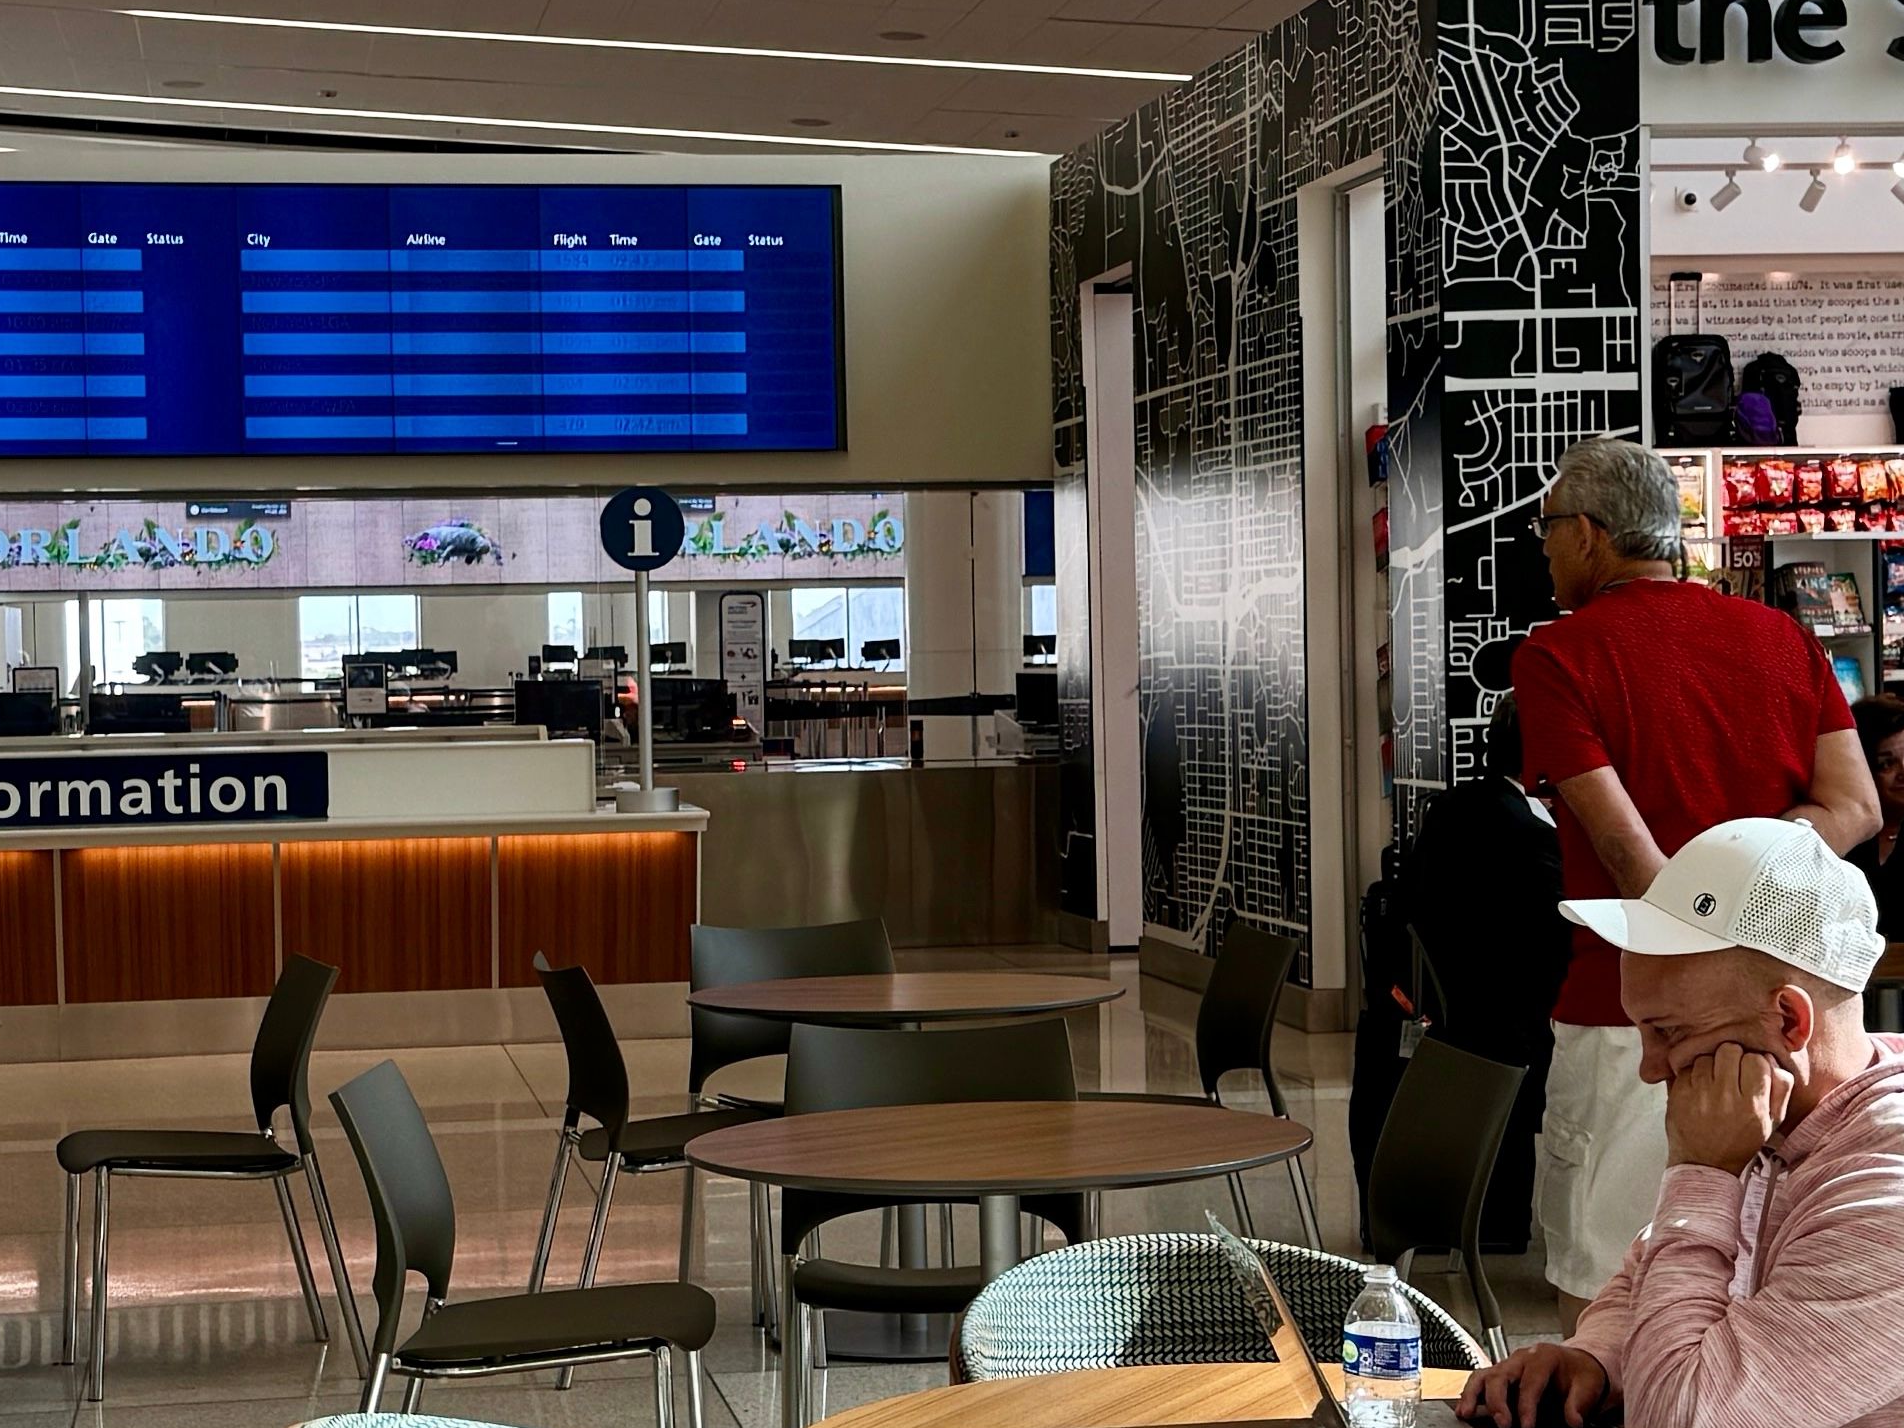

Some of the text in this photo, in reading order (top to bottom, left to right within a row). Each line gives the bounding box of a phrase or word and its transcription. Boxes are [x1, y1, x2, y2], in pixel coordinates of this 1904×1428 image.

[87, 232, 118, 245] Gate
[146, 232, 184, 245] Status
[246, 233, 271, 249] City
[406, 233, 446, 246] Airline
[553, 233, 588, 249] Flight
[609, 233, 638, 246] Time
[693, 233, 722, 246] Gate
[748, 234, 784, 246] Status
[1820, 280, 1830, 290] It
[1833, 281, 1853, 290] was
[1856, 279, 1881, 290] first
[1720, 299, 1729, 309] it
[1733, 298, 1744, 308] is
[1746, 299, 1770, 308] said
[1773, 297, 1797, 308] that
[1801, 296, 1824, 309] they
[1827, 297, 1870, 309] scooped
[1873, 296, 1890, 307] the
[1705, 315, 1759, 325] witnessed
[1761, 315, 1774, 327] by
[1777, 316, 1784, 324] a
[1787, 313, 1803, 324] lot
[1805, 314, 1817, 324] of
[1820, 313, 1854, 325] people
[1857, 314, 1868, 323] at
[1870, 314, 1889, 323] one
[1778, 331, 1825, 341] directed
[1827, 332, 1834, 341] a
[1837, 330, 1871, 341] movie,
[1818, 348, 1839, 357] who
[1842, 348, 1877, 358] scoops
[1820, 365, 1833, 374] as
[1873, 362, 1904, 373] which
[1812, 381, 1823, 391] to
[1824, 382, 1856, 392] empty
[1859, 380, 1871, 392] by
[1835, 398, 1861, 407] used
[1863, 398, 1876, 406] as
[684, 516, 905, 554] LANDO
